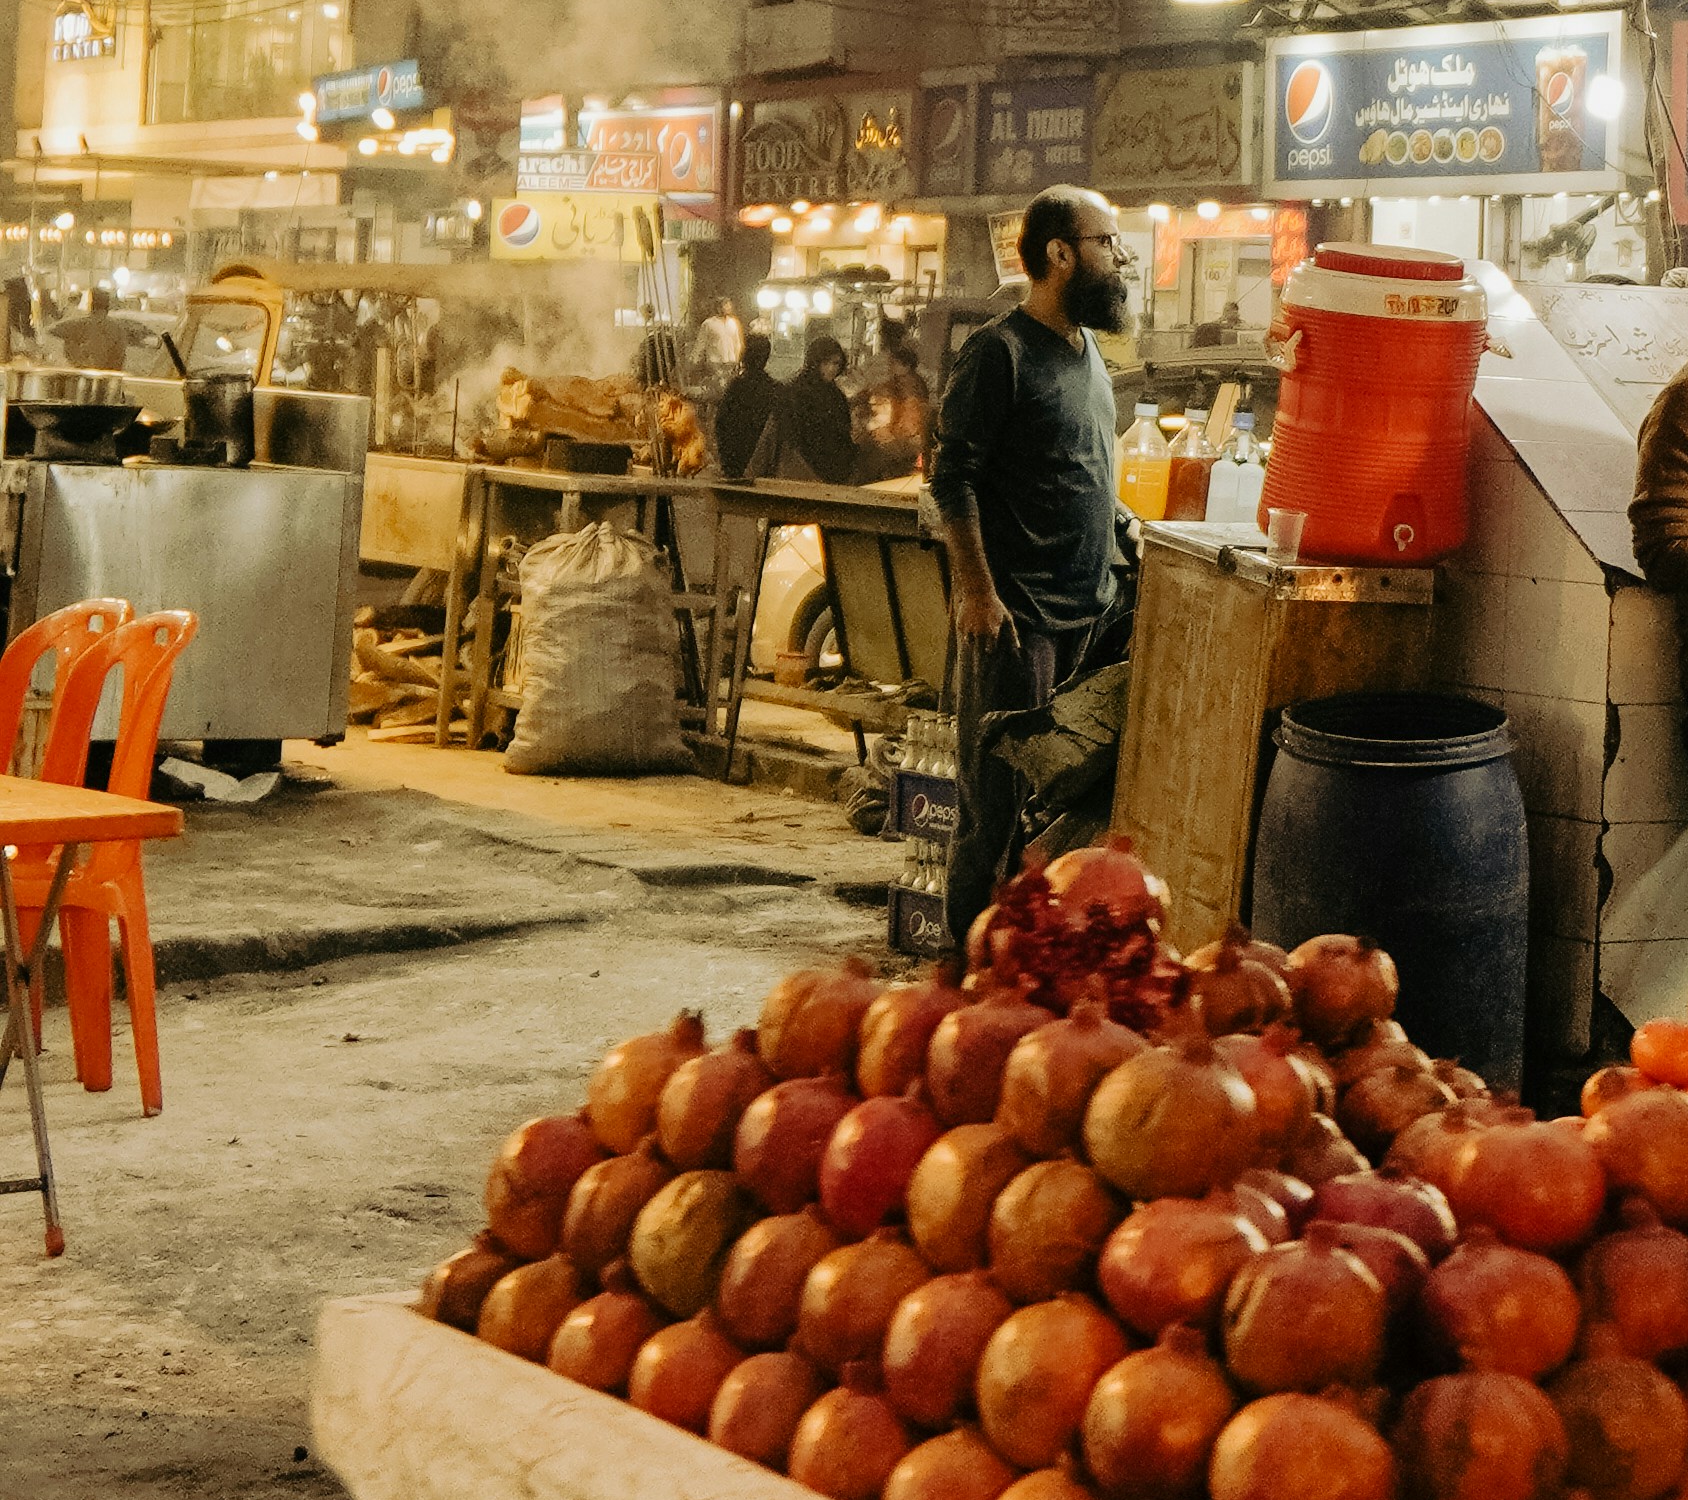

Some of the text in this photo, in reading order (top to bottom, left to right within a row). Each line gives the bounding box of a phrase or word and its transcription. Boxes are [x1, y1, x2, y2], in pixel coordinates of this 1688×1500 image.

[393, 73, 422, 99] peps
[1549, 119, 1571, 132] pepsi
[517, 152, 586, 174] arachi
[1288, 145, 1332, 170] pepsi
[517, 176, 571, 189] ALEEM
[929, 804, 956, 822] peps
